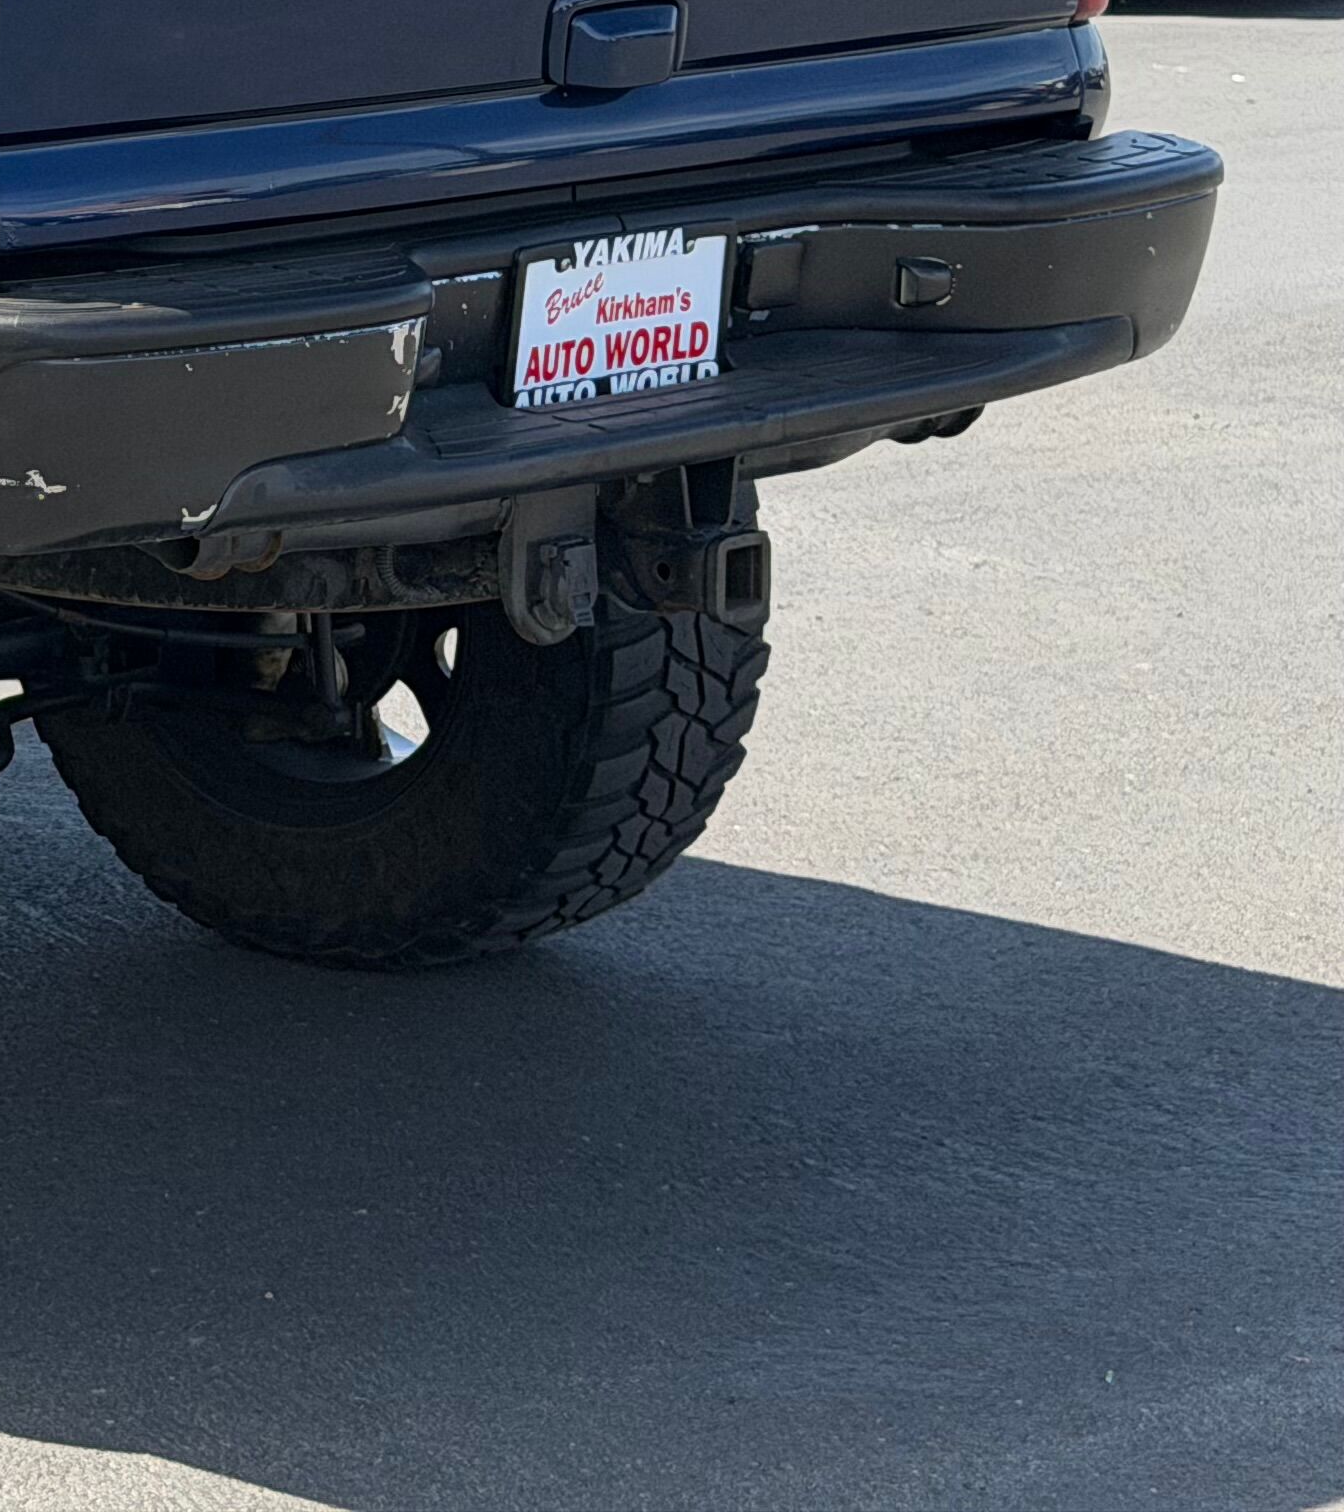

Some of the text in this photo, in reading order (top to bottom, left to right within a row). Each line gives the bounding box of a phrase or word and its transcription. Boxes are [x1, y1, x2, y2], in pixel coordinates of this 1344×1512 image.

[574, 227, 684, 268] YAKIMA
[545, 272, 604, 325] Bruce
[595, 287, 692, 324] Kirkham's
[523, 320, 709, 386] AUTO WORLD
